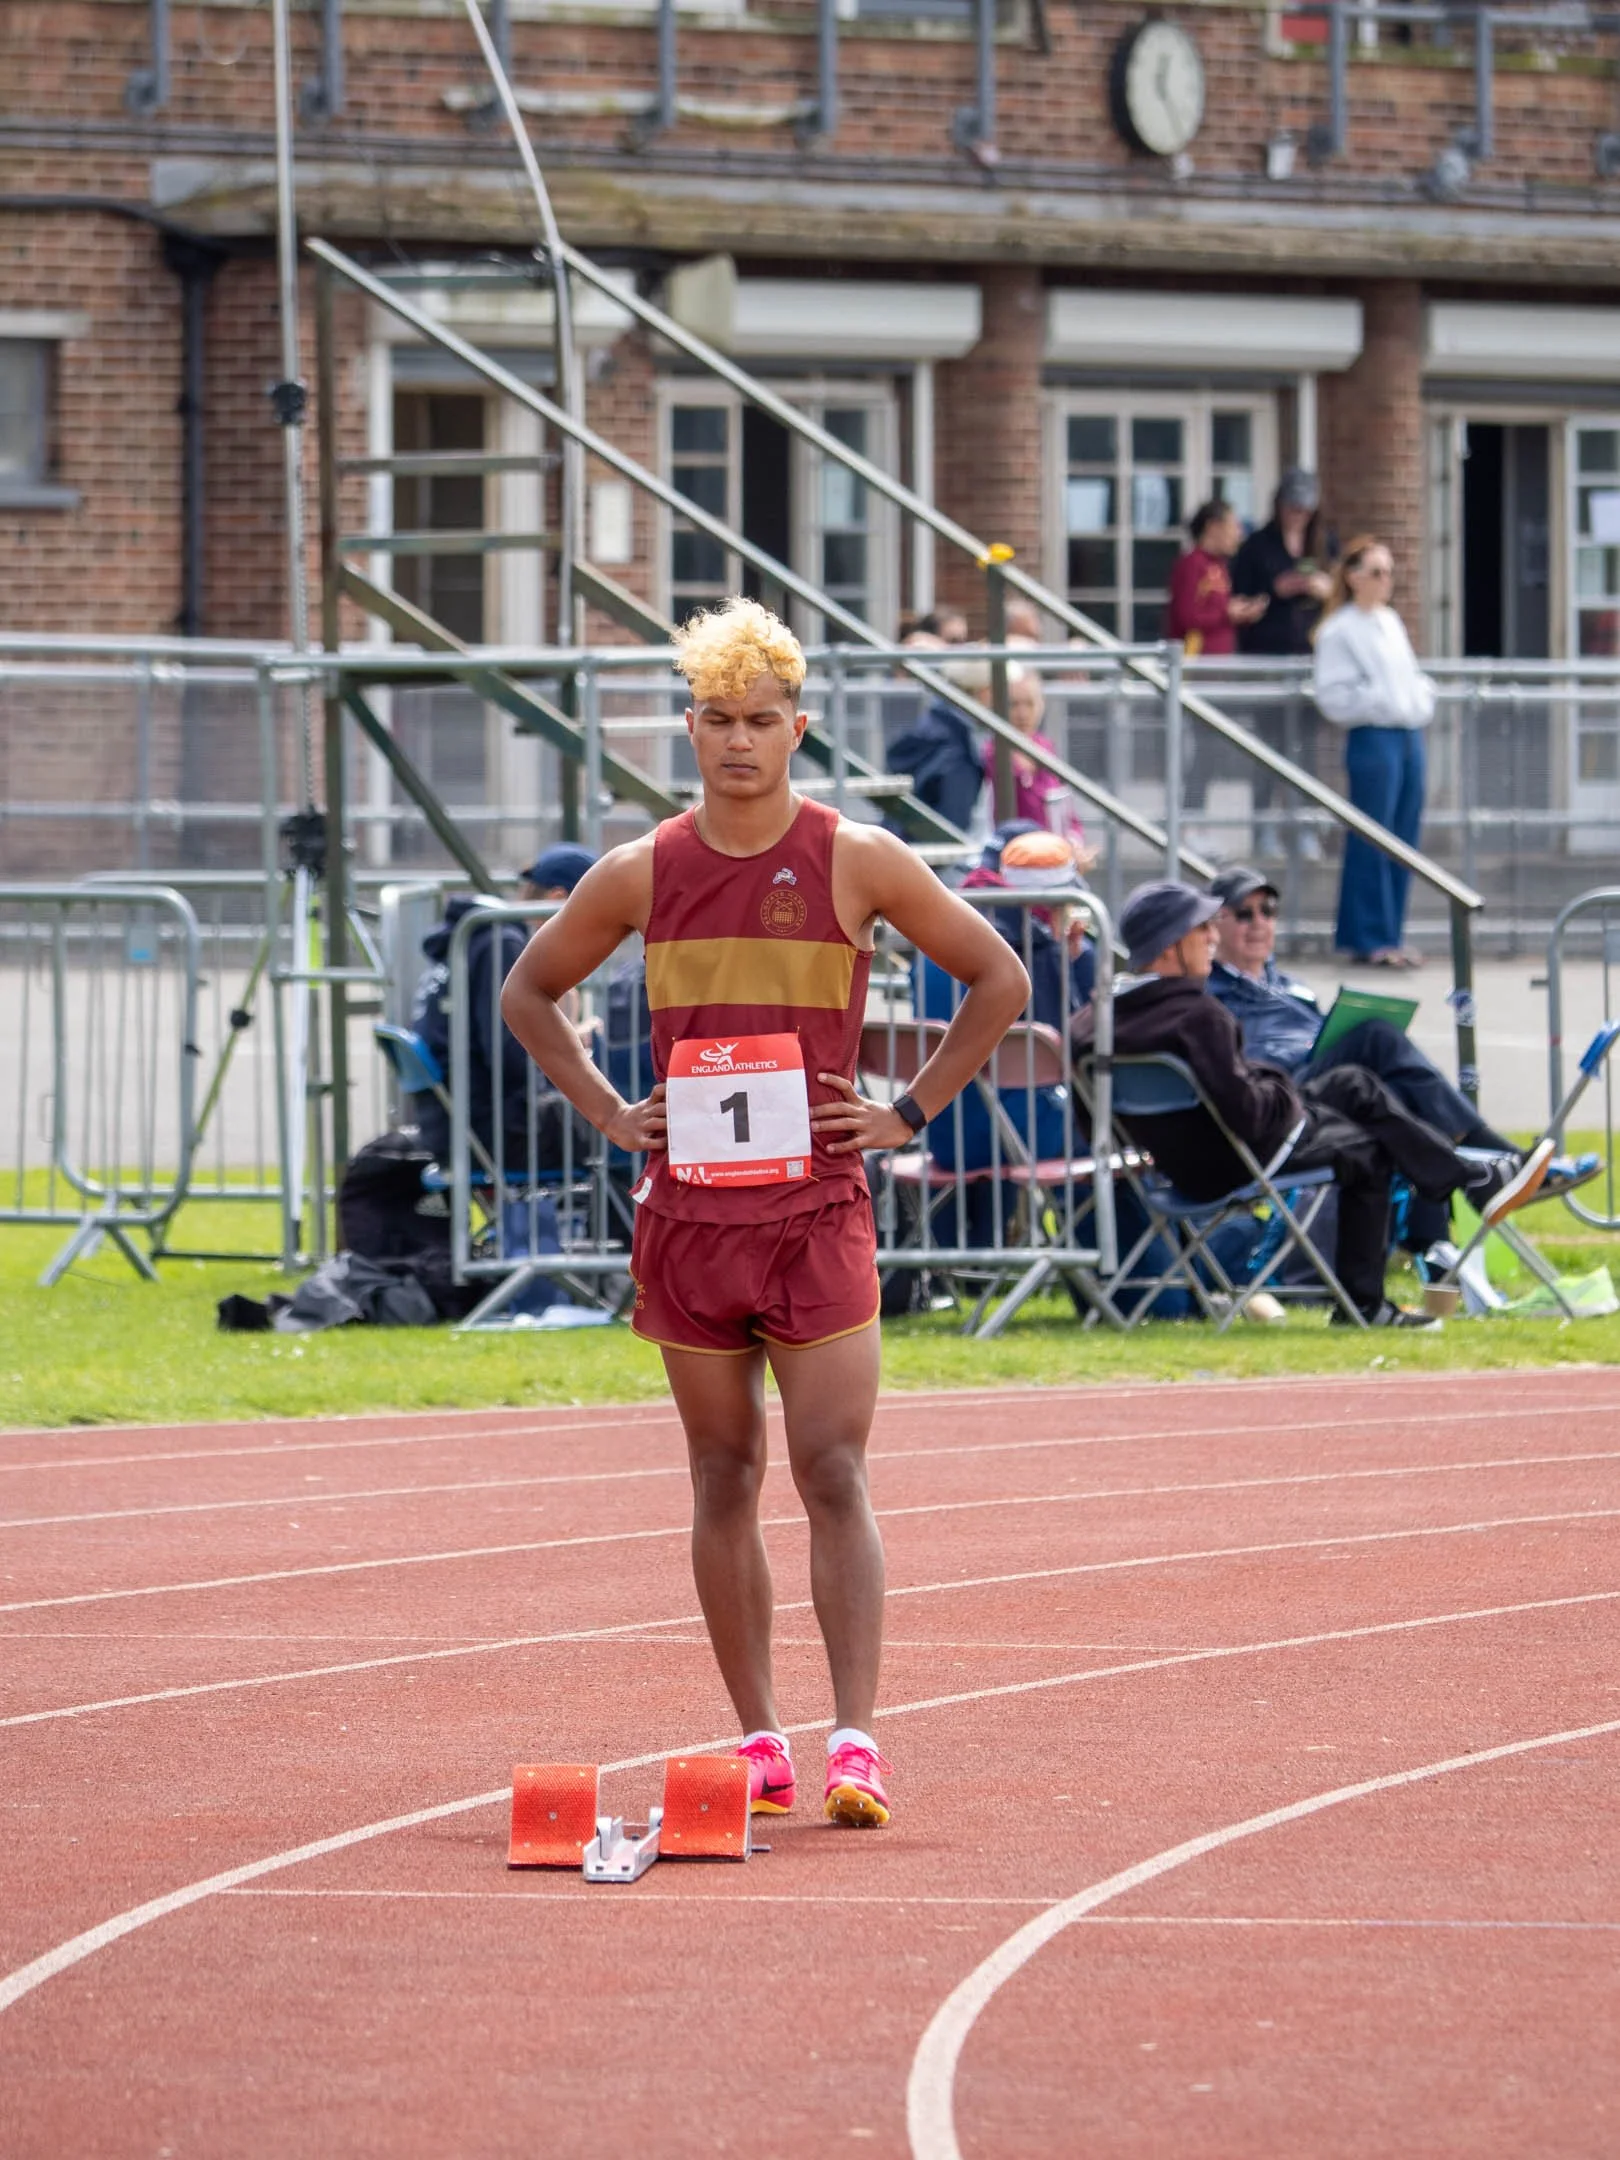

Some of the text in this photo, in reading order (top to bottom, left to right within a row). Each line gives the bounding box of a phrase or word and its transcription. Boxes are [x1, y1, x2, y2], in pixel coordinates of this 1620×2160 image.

[691, 1060, 778, 1074] ENGLAND ATHLETICS
[720, 1092, 750, 1143] 1
